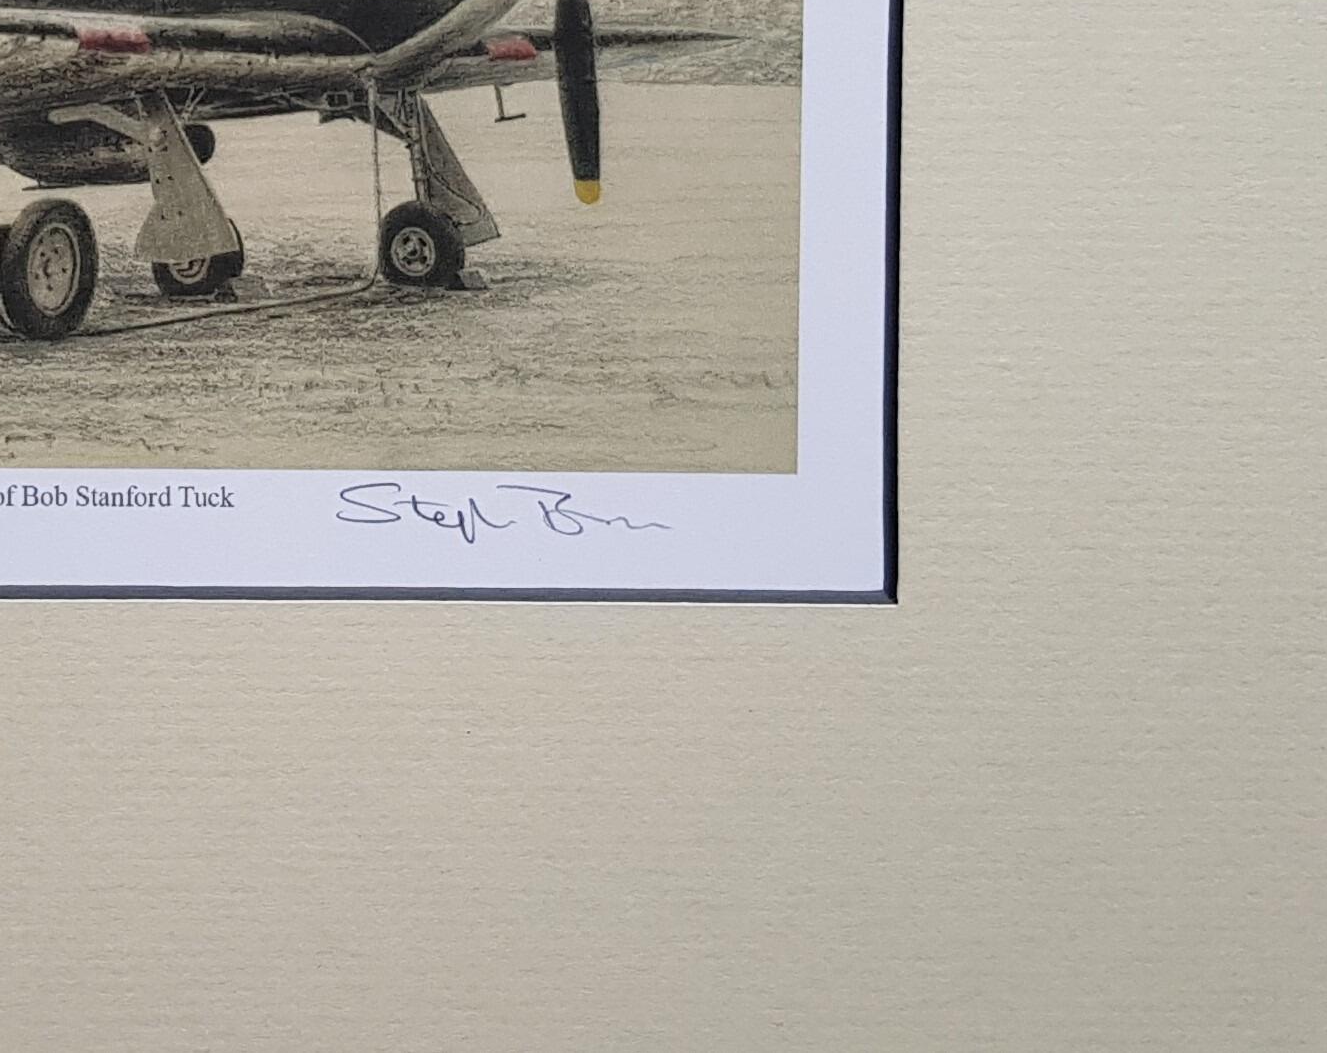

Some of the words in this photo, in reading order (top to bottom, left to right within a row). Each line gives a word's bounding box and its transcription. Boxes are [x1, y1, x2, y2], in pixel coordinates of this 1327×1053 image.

[22, 485, 68, 507] Bob
[76, 485, 172, 507] Stanford
[178, 485, 235, 507] Tuck
